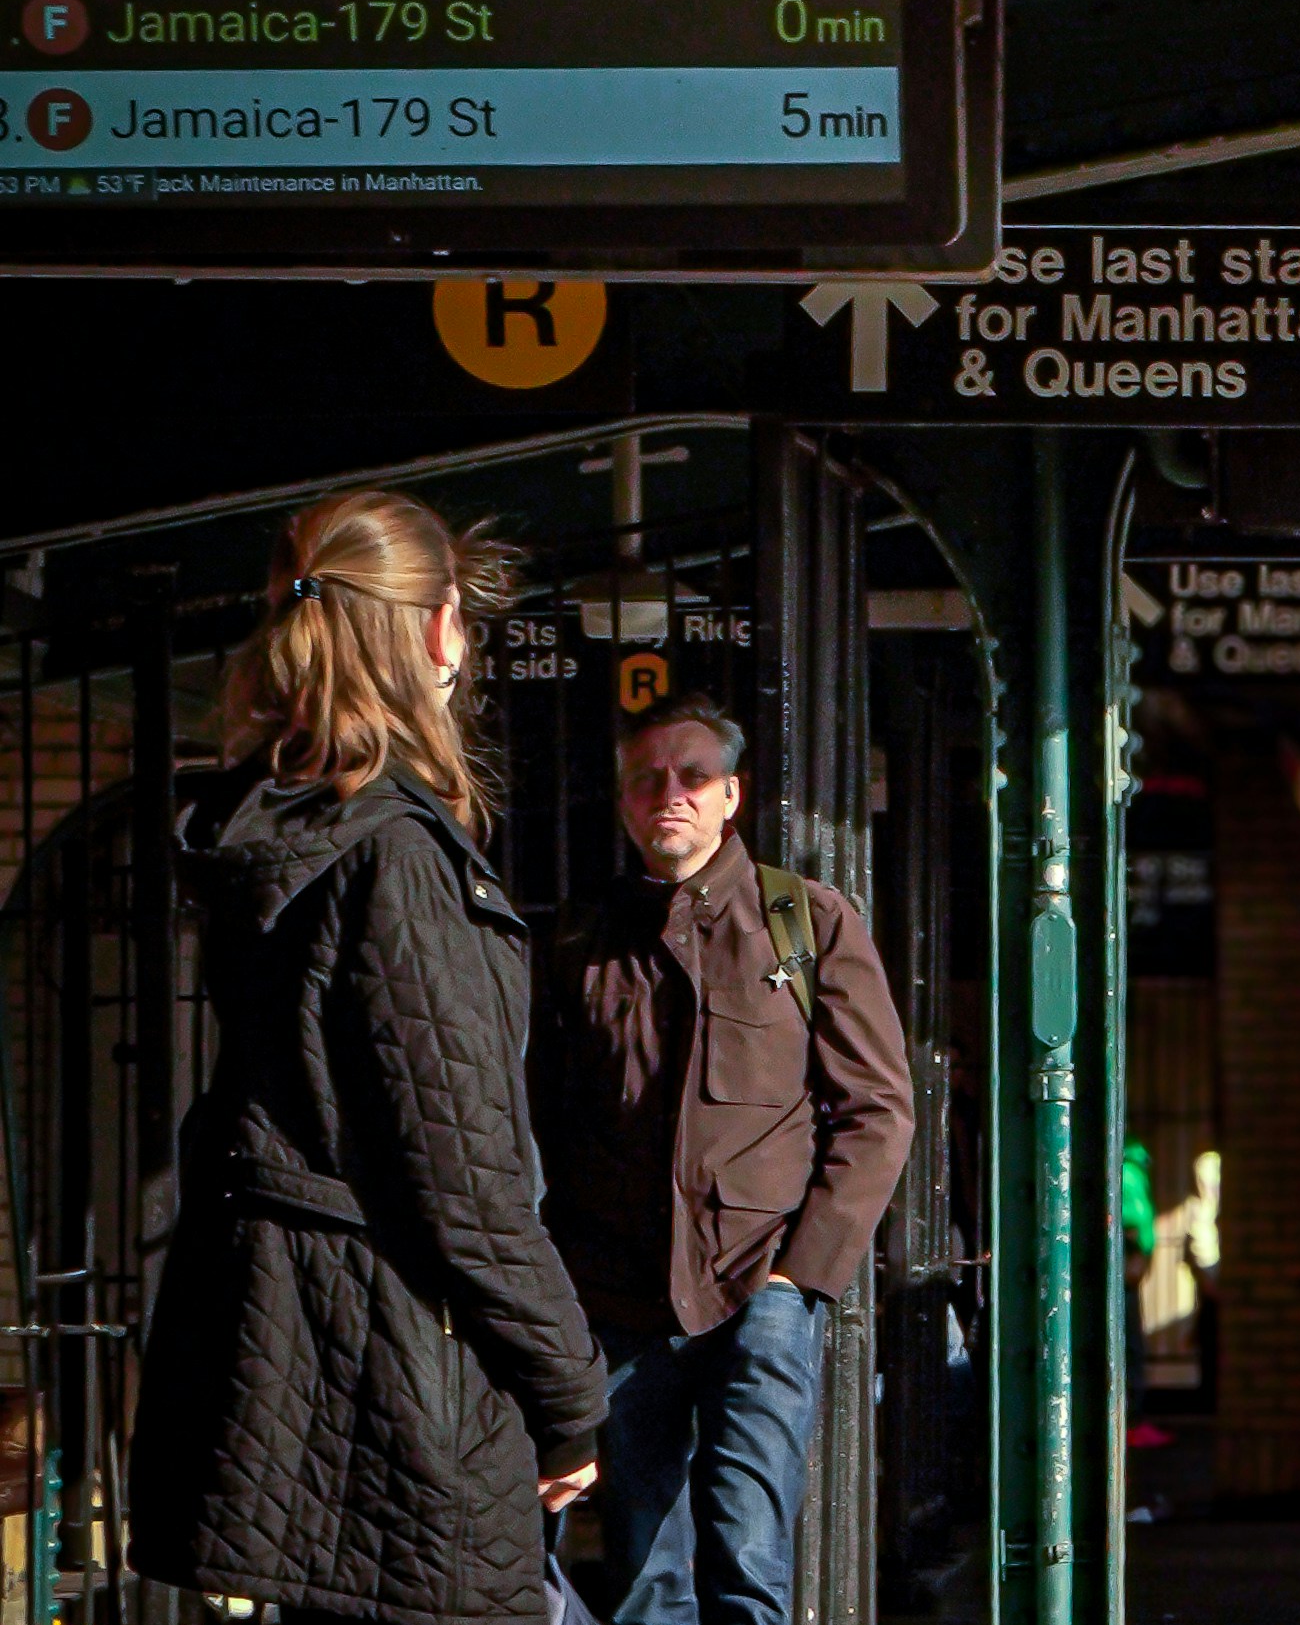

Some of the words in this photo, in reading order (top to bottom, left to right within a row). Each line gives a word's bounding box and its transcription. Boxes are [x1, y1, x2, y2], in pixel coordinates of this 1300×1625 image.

[106, 2, 429, 43] Jamaica-179
[445, 2, 496, 42] St
[817, 10, 885, 43] min
[110, 98, 431, 139] Jamaica-179
[448, 98, 498, 138] St
[781, 92, 811, 138] 5
[819, 105, 889, 138] min
[24, 174, 62, 194] PM
[200, 172, 336, 193] Maintenance
[341, 174, 360, 192] in
[366, 172, 484, 192] Manhattan.
[998, 244, 1065, 285] se
[1091, 236, 1195, 285] last
[485, 280, 557, 347] R
[956, 293, 1037, 341] for
[953, 349, 996, 397] &
[1024, 348, 1248, 399] Queens
[1170, 565, 1244, 596] Use
[505, 618, 557, 649] Sts
[1170, 601, 1228, 634] for
[510, 652, 579, 680] side
